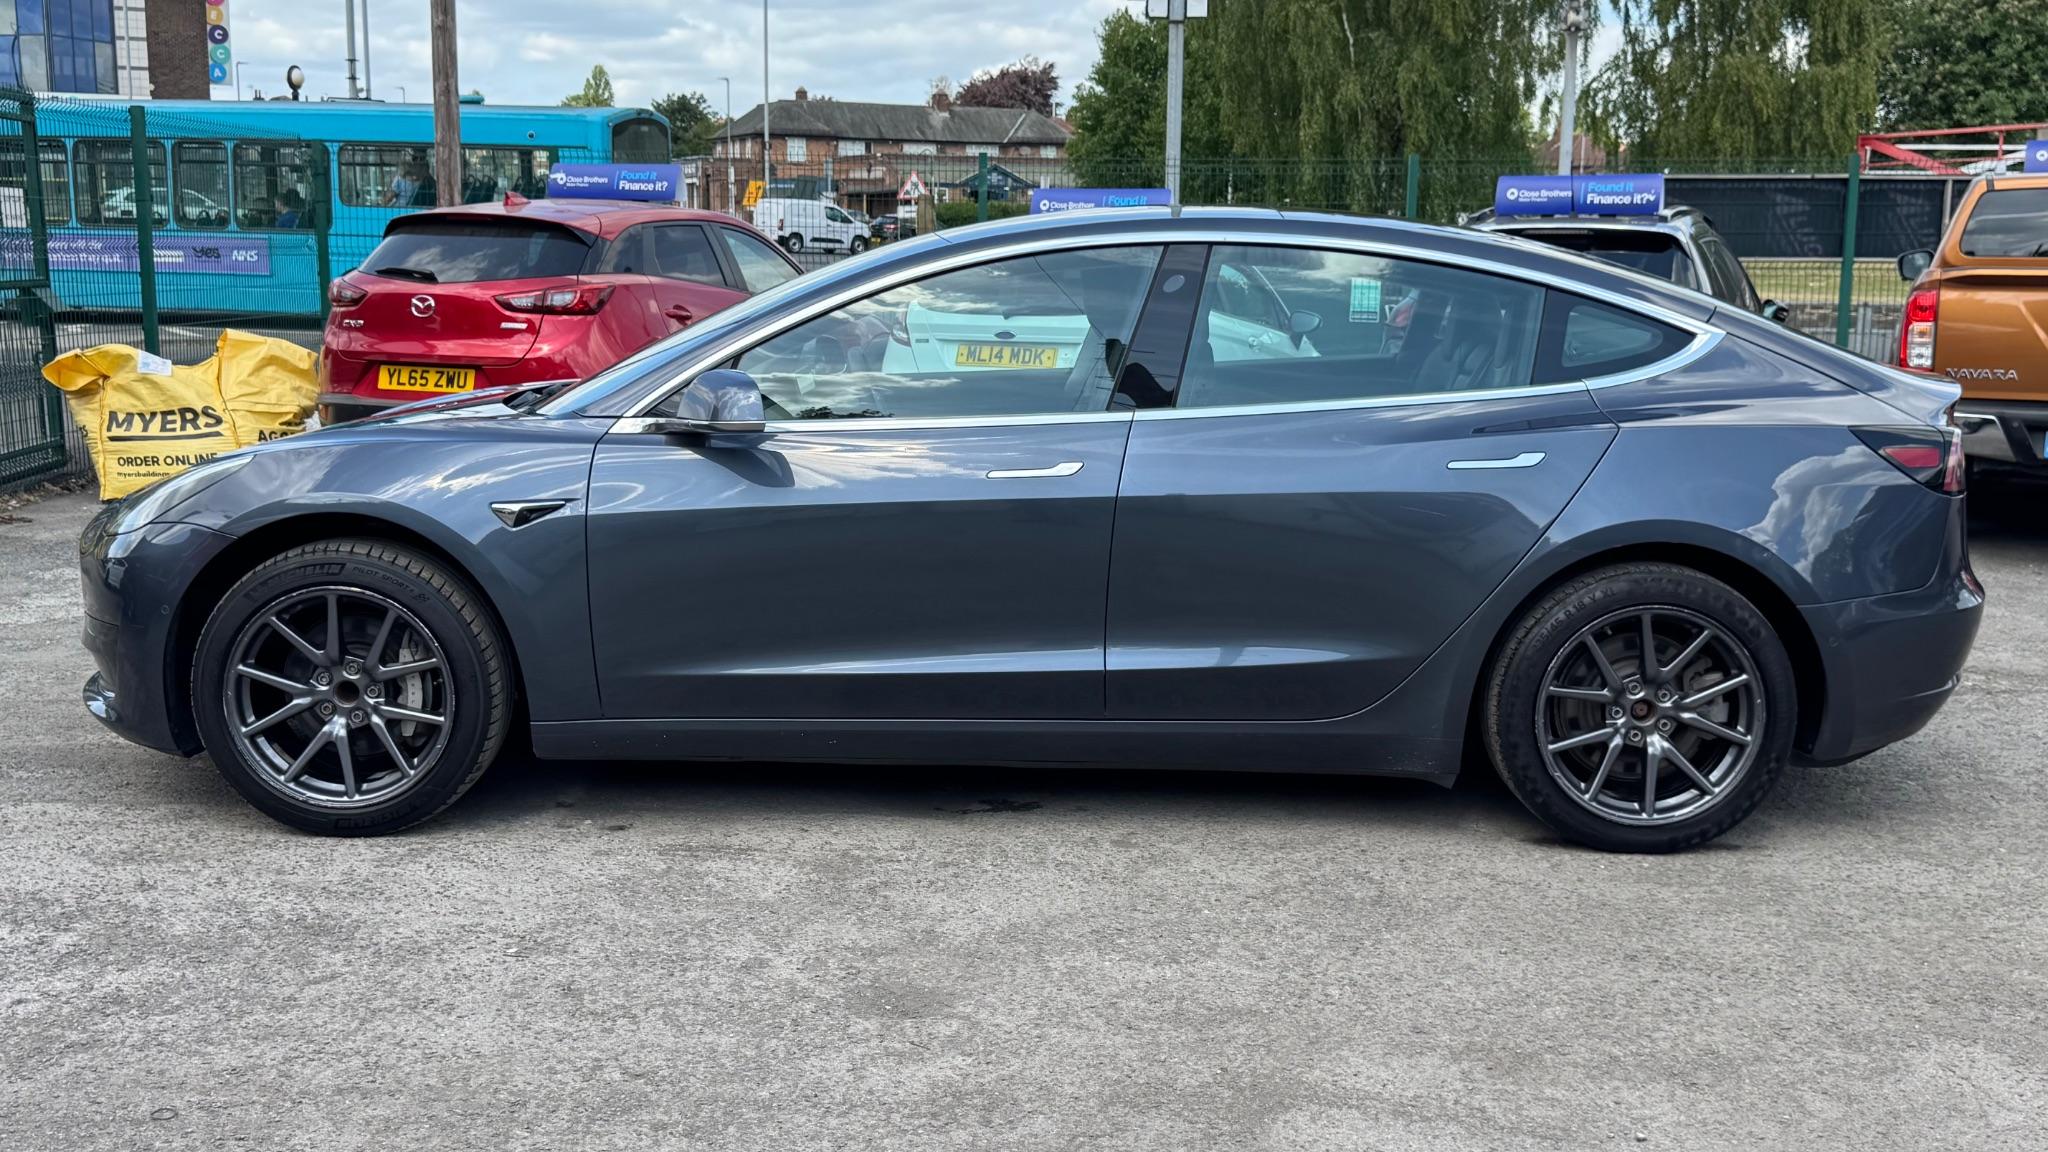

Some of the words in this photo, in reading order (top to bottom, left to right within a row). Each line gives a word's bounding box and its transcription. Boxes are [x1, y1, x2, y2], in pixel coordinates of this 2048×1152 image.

[621, 171, 649, 180] Found
[650, 171, 657, 179] it
[619, 181, 654, 191] Finance
[655, 181, 668, 191] it?
[1588, 182, 1624, 192] Found
[1625, 182, 1633, 192] it
[1540, 190, 1572, 198] Brothers
[1586, 193, 1631, 204] Finance
[1633, 193, 1647, 204] it?
[1108, 195, 1138, 206] Found
[232, 249, 258, 261] NHS
[966, 345, 1004, 364] ML14
[1009, 348, 1046, 365] MDK
[388, 368, 429, 387] YL65
[434, 370, 468, 389] ZWU
[1945, 368, 2019, 381] NAVARA
[107, 405, 224, 433] MYERS
[117, 455, 160, 467] ORDER
[352, 567, 379, 577] PILOT
[382, 574, 410, 589] SPORT
[1564, 611, 1574, 619] R
